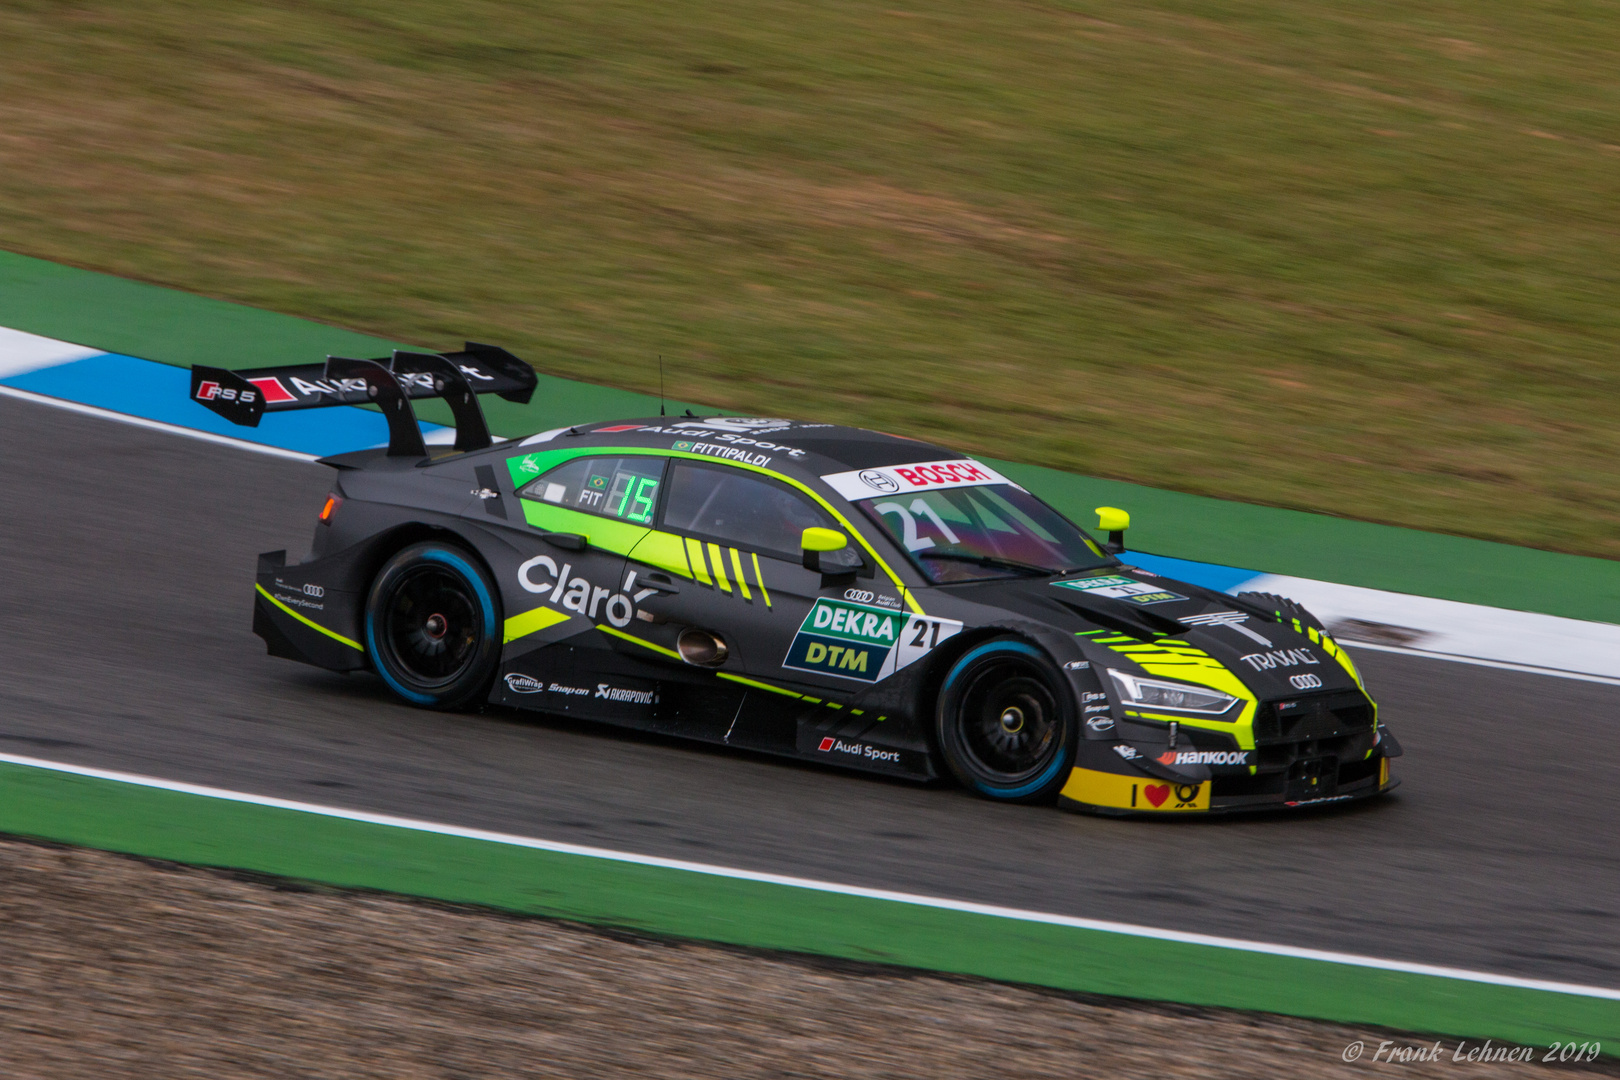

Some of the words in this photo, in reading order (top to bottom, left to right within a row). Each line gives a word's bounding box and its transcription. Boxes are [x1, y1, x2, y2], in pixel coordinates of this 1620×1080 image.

[637, 425, 715, 438] Audi
[715, 433, 806, 457] Sport
[691, 442, 772, 468] FITTIPALDI
[894, 463, 992, 487] BOSCH
[579, 489, 603, 507] FIT
[874, 498, 960, 553] 21
[517, 555, 633, 628] Claro
[813, 604, 894, 641] DEKRA
[909, 619, 941, 649] 21
[805, 641, 868, 673] DTM
[507, 676, 544, 689] GrafiWrap
[548, 682, 590, 696] Snap-on
[834, 740, 862, 755] Audi
[864, 746, 900, 762] Sport
